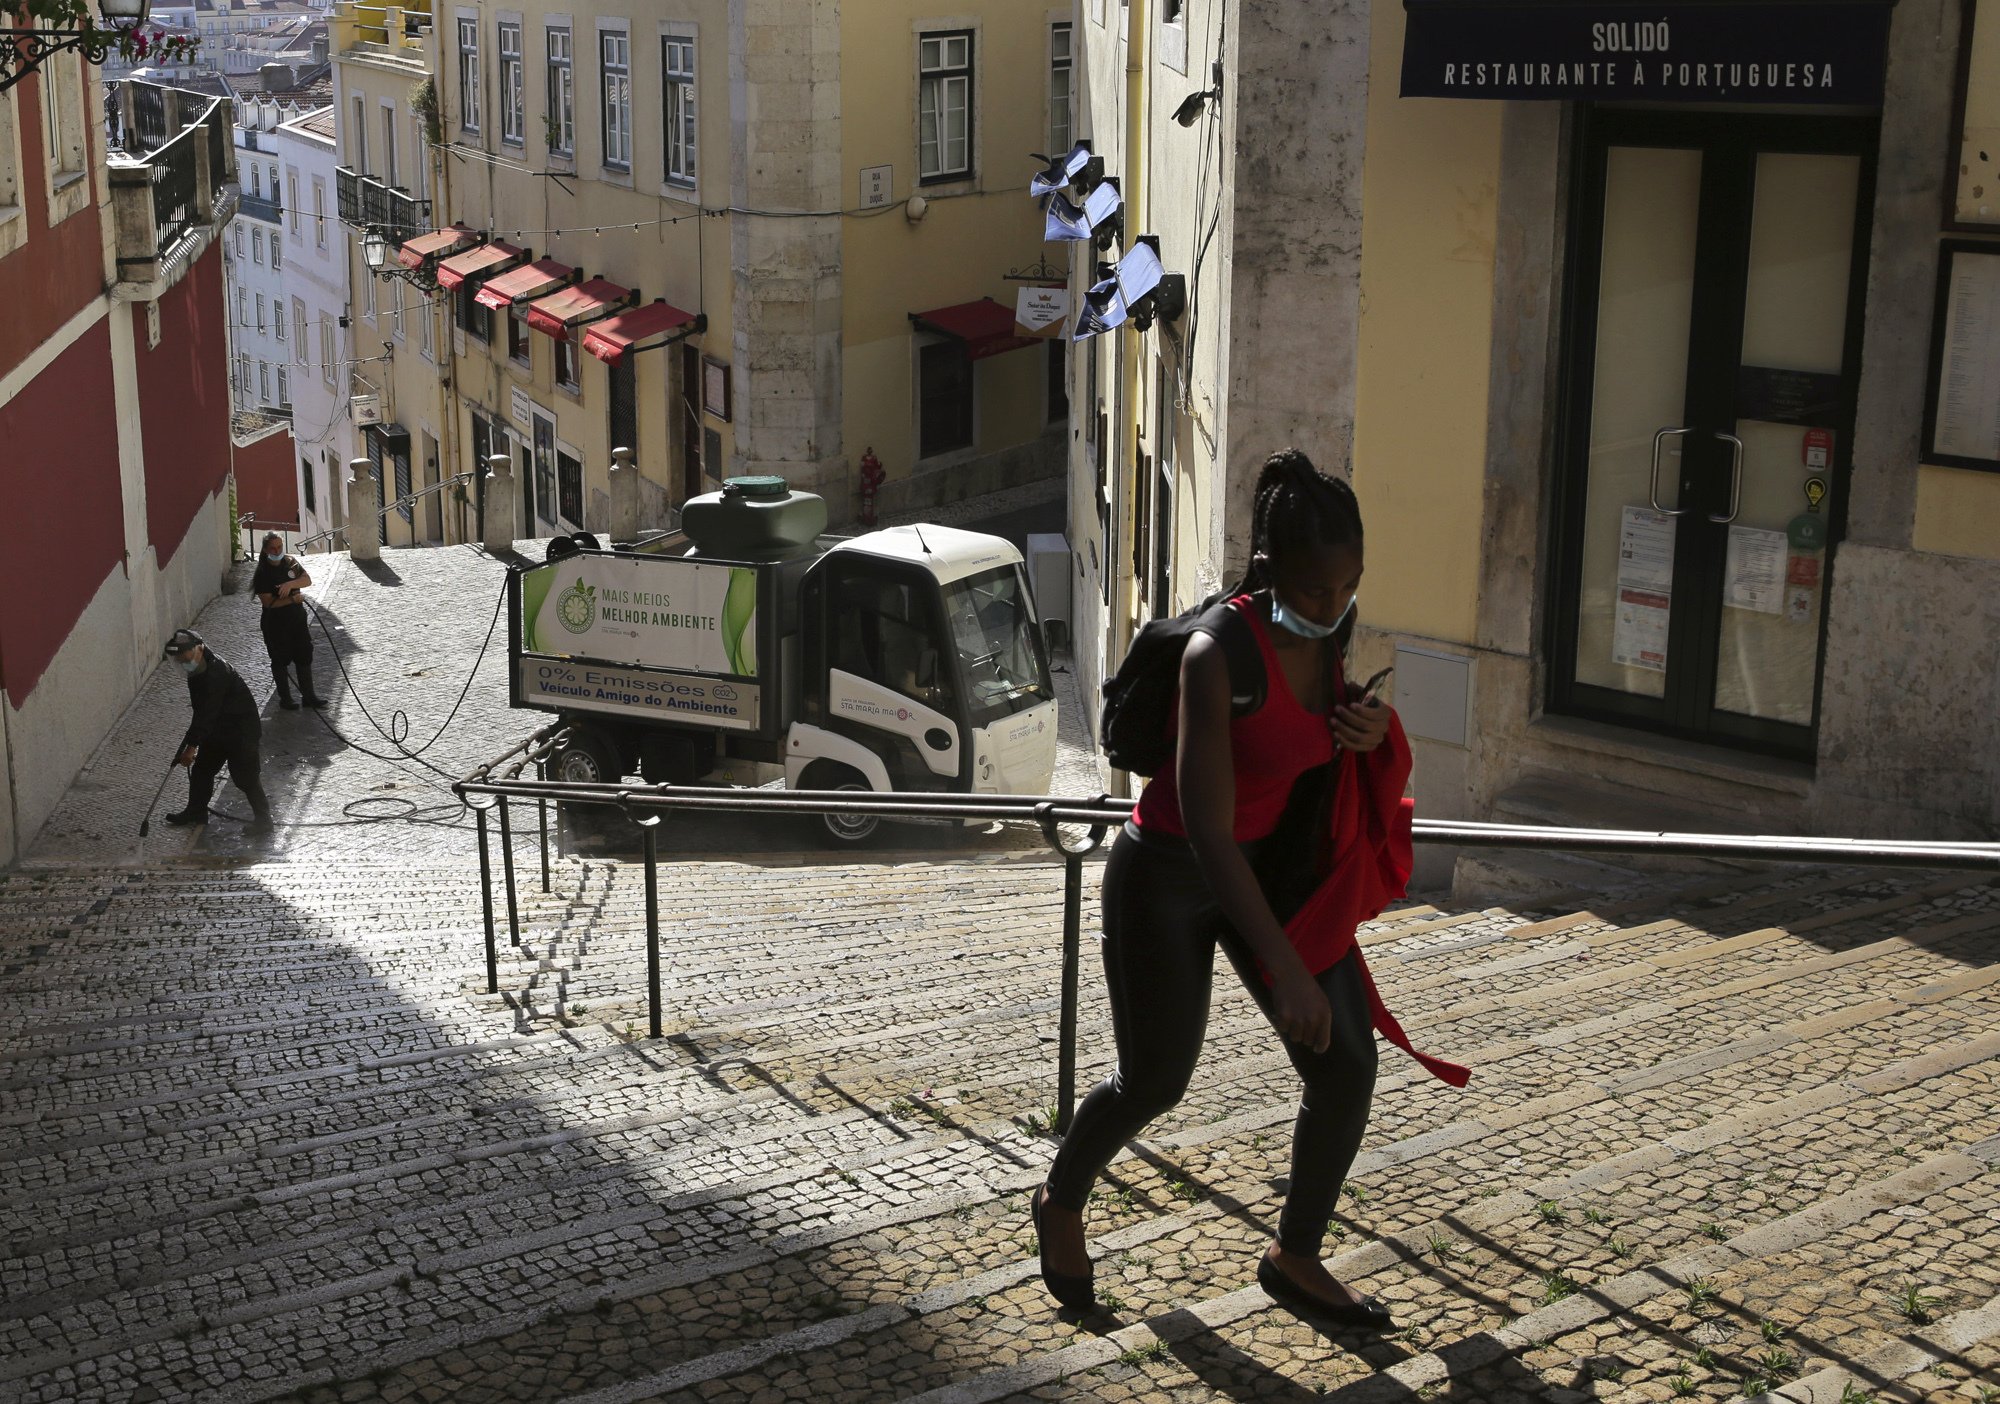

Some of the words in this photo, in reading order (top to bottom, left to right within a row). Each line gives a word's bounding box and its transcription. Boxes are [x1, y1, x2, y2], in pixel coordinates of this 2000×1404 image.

[1592, 16, 1669, 52] SOLIDÓ
[1444, 63, 1616, 86] RESTAURANTE
[1633, 59, 1645, 86] À
[1663, 63, 1833, 88] PORTUGUESA
[872, 172, 881, 180] RUA
[873, 183, 880, 192] DO
[869, 193, 884, 204] DUQUE
[602, 588, 629, 604] MAIS
[633, 591, 670, 607] MEIOS
[602, 606, 648, 625] MELHOR
[652, 612, 715, 631] AMBIENTE
[538, 665, 576, 682] 0%
[586, 671, 706, 697] Emissões
[539, 680, 591, 697] Veículo
[595, 687, 641, 706] Amigo
[644, 693, 662, 706] do
[668, 696, 738, 716] Ambiente
[714, 688, 731, 698] CO2
[855, 704, 880, 715] MARIA
